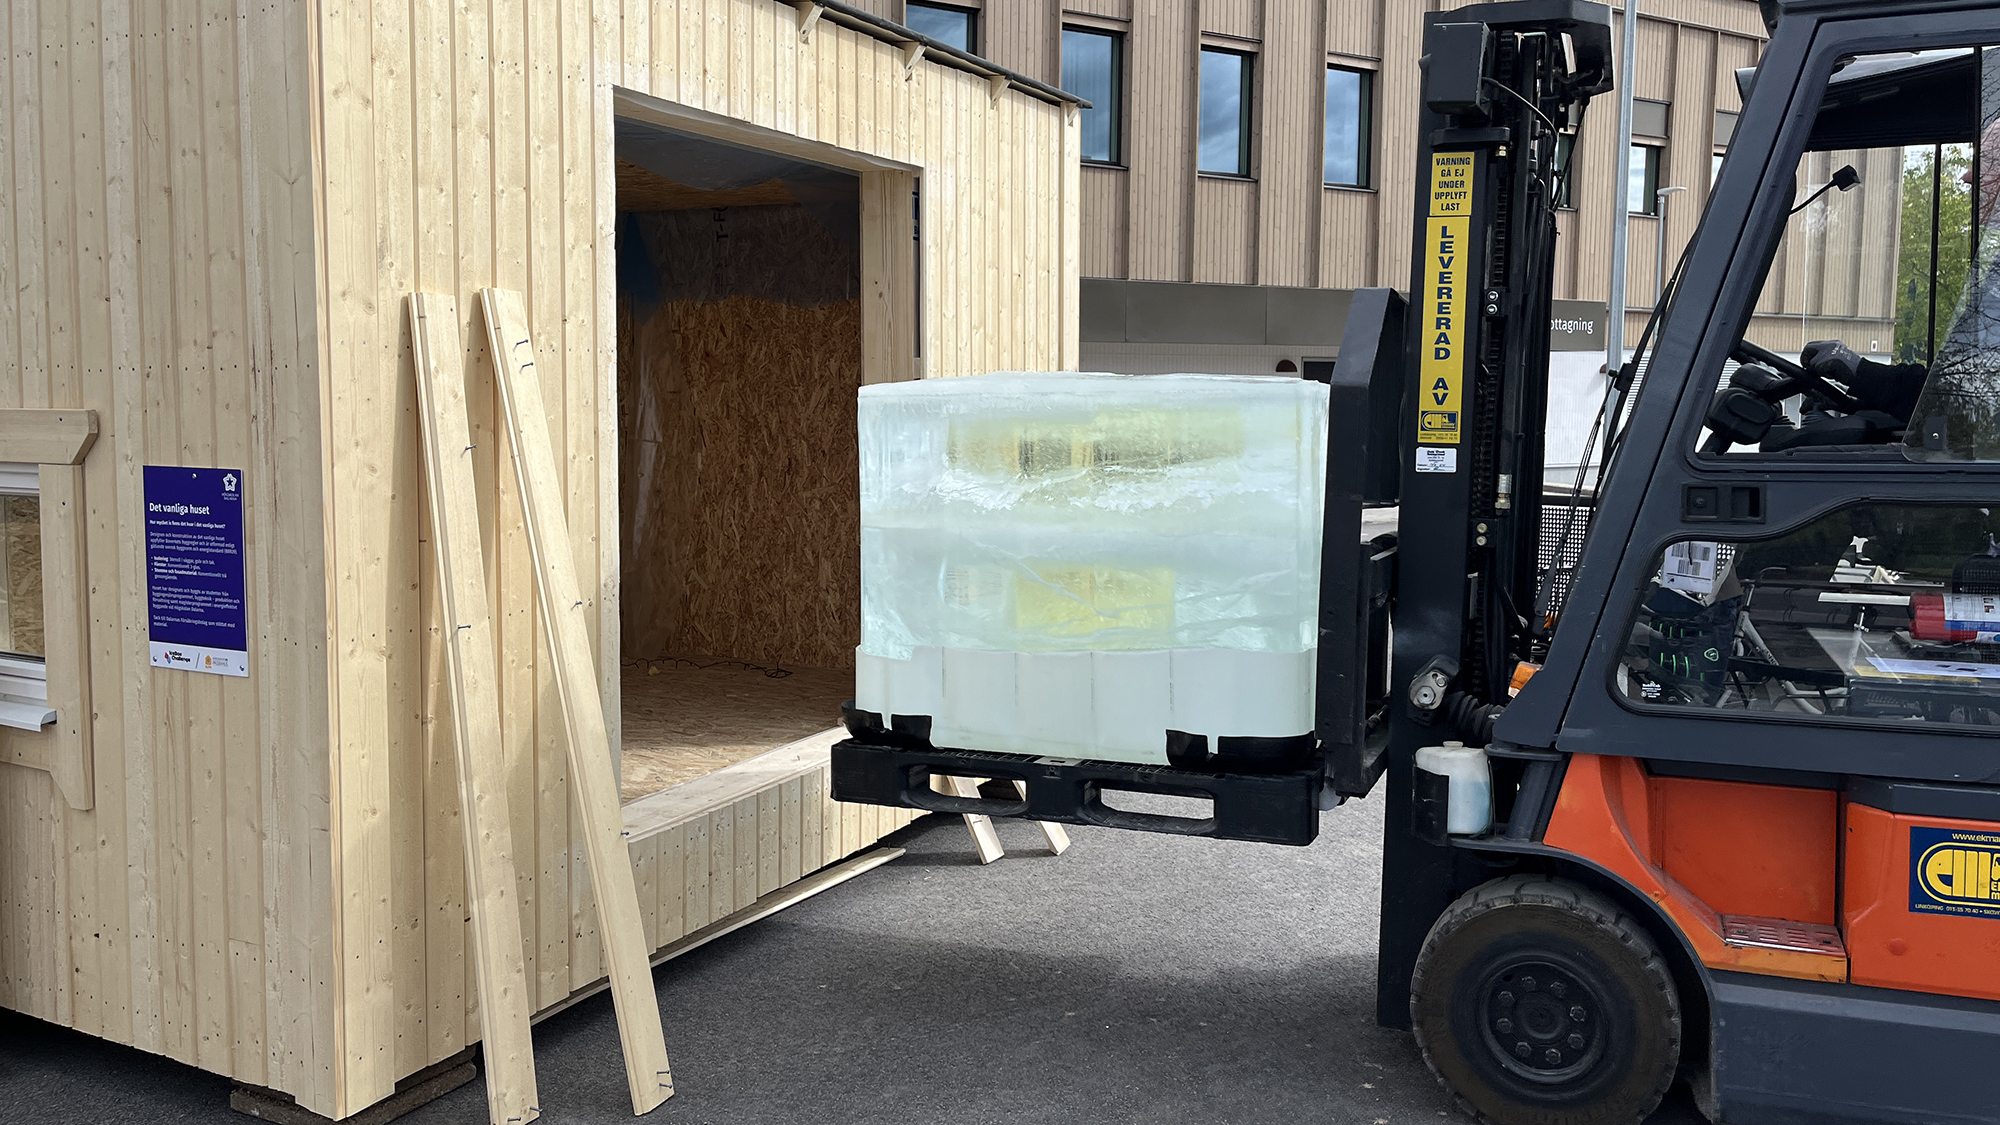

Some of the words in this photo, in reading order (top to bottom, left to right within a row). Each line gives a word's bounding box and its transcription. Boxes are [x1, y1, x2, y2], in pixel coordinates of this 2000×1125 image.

[1436, 157, 1471, 166] VARNING
[1441, 167, 1451, 177] GÅ
[1455, 169, 1464, 177] EJ
[1439, 180, 1465, 188] UNDER
[1435, 191, 1467, 200] UPPLYFT
[1441, 203, 1460, 211] LAST
[1433, 225, 1455, 360] LEVERERAD
[1432, 377, 1449, 406] AV
[149, 502, 162, 512] Det
[163, 503, 188, 515] vanliga
[190, 504, 210, 515] huset
